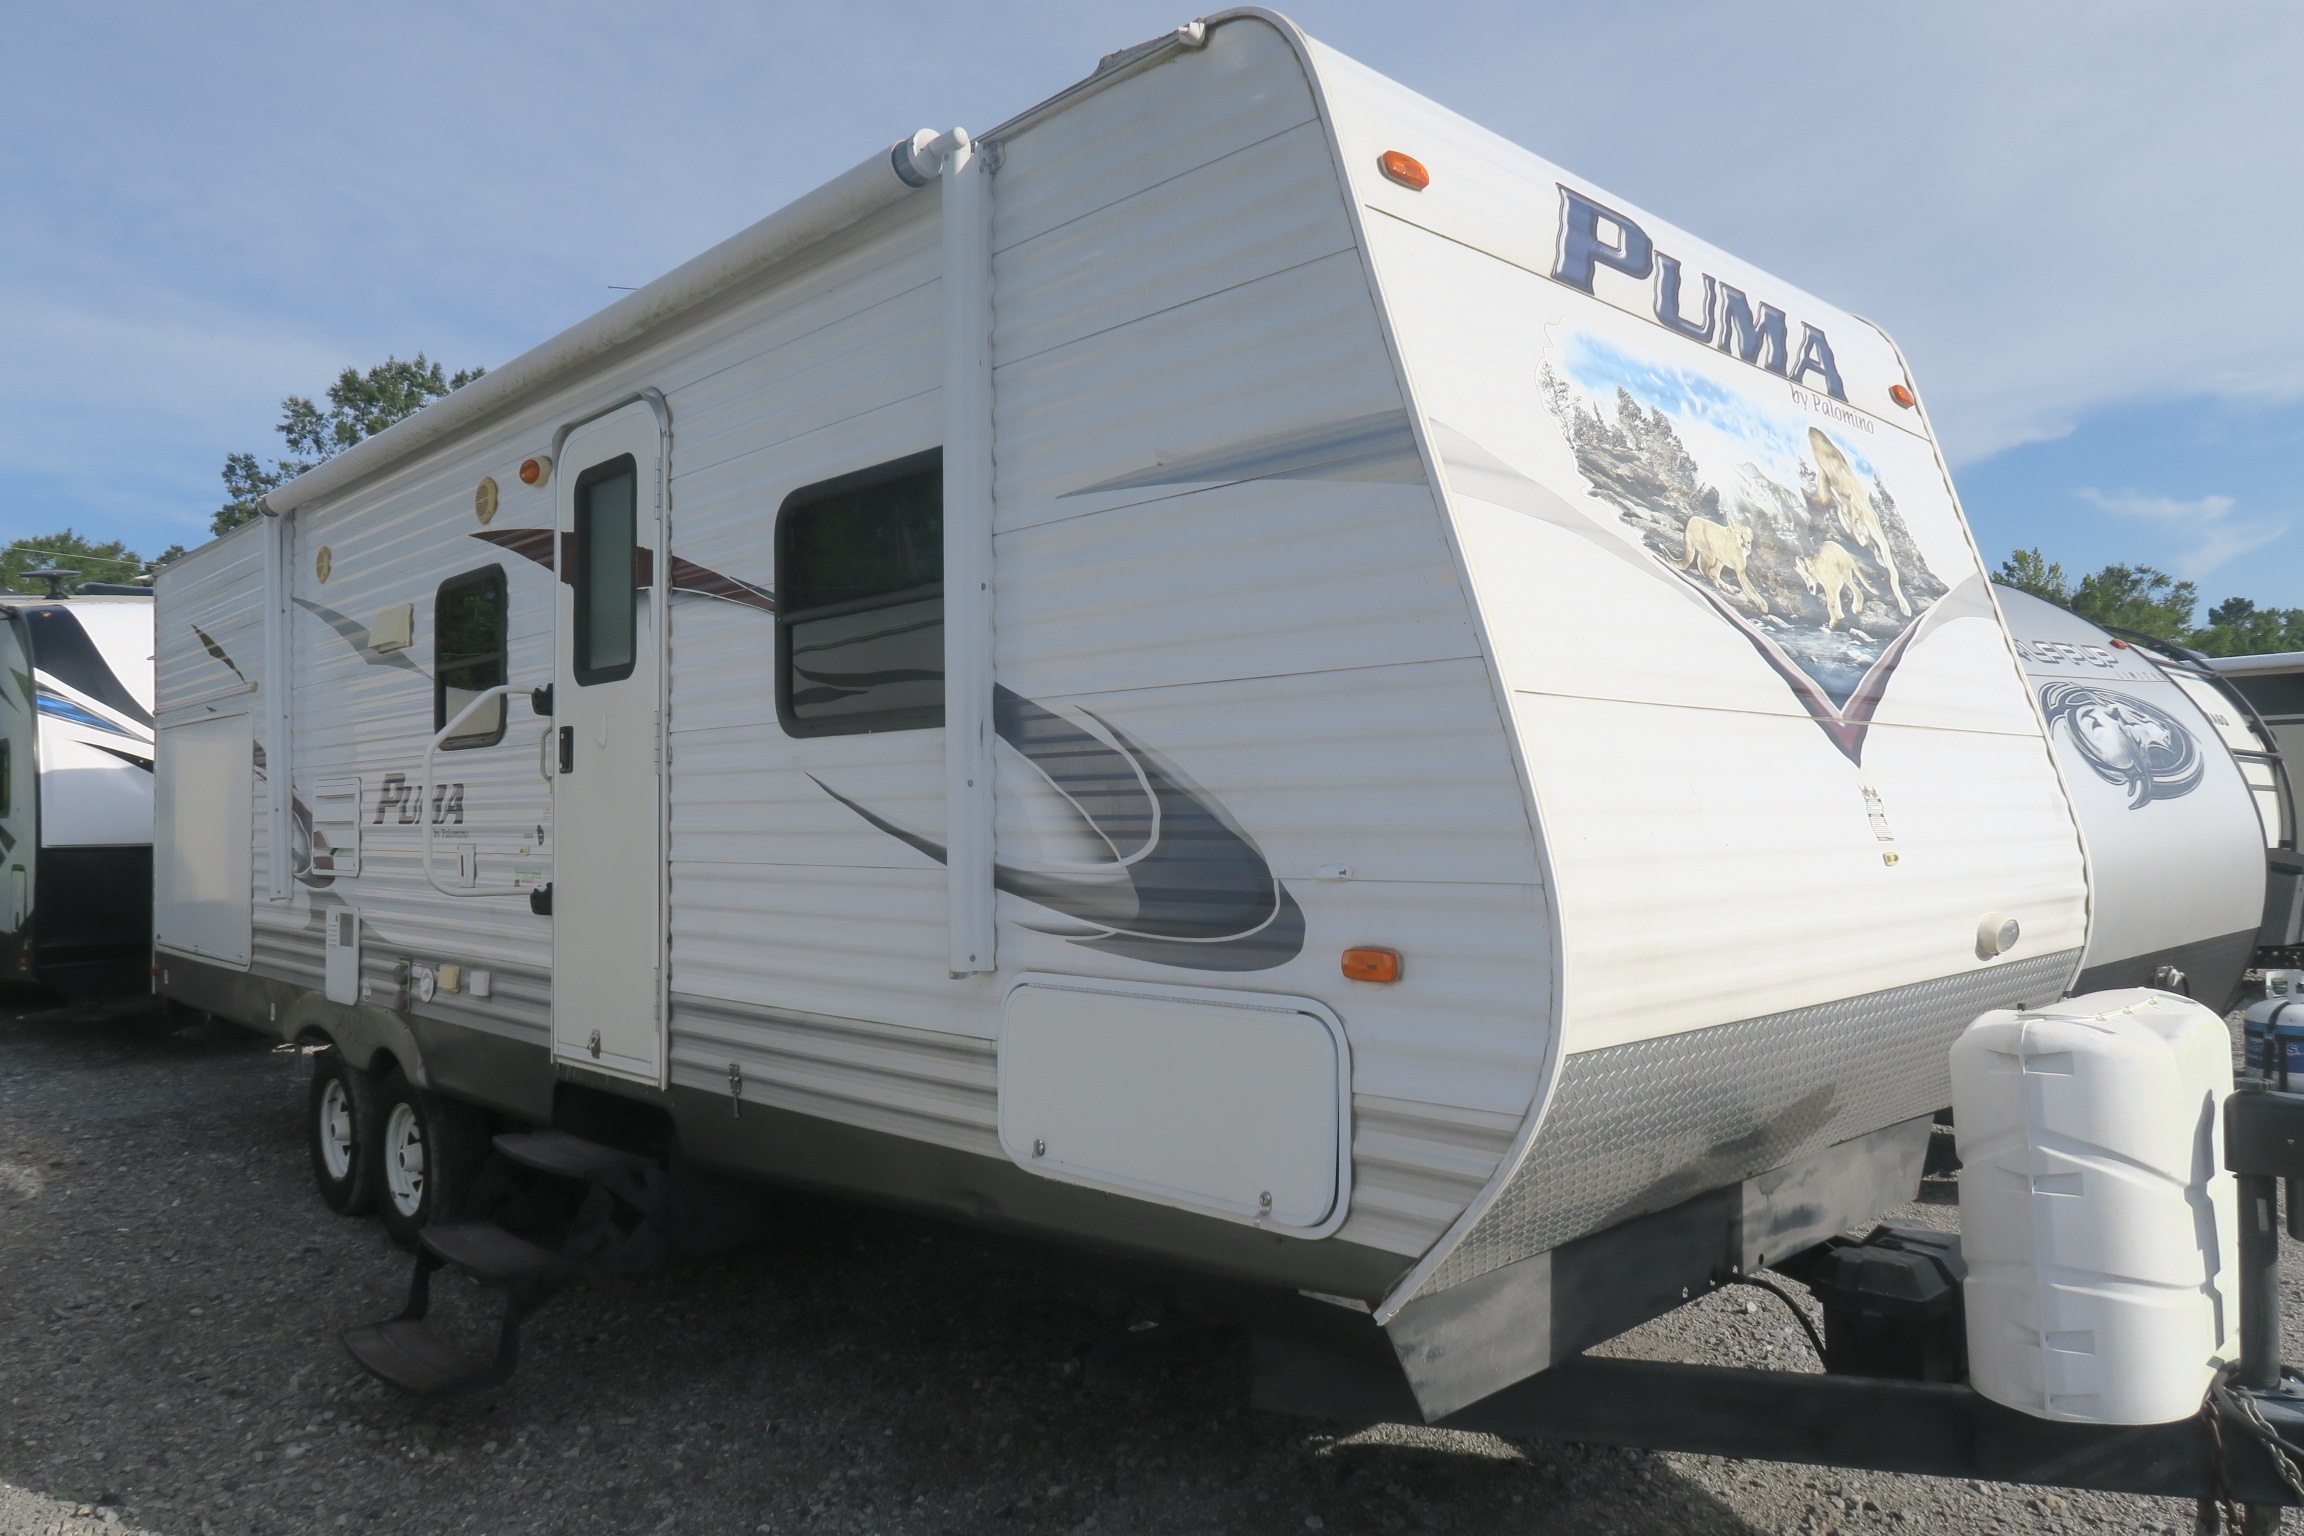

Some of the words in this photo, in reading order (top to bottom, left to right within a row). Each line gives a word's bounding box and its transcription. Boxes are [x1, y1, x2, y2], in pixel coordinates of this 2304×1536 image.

[1551, 182, 1849, 404] PUMA
[1788, 383, 1808, 411] by
[1811, 393, 1875, 435] Palomino
